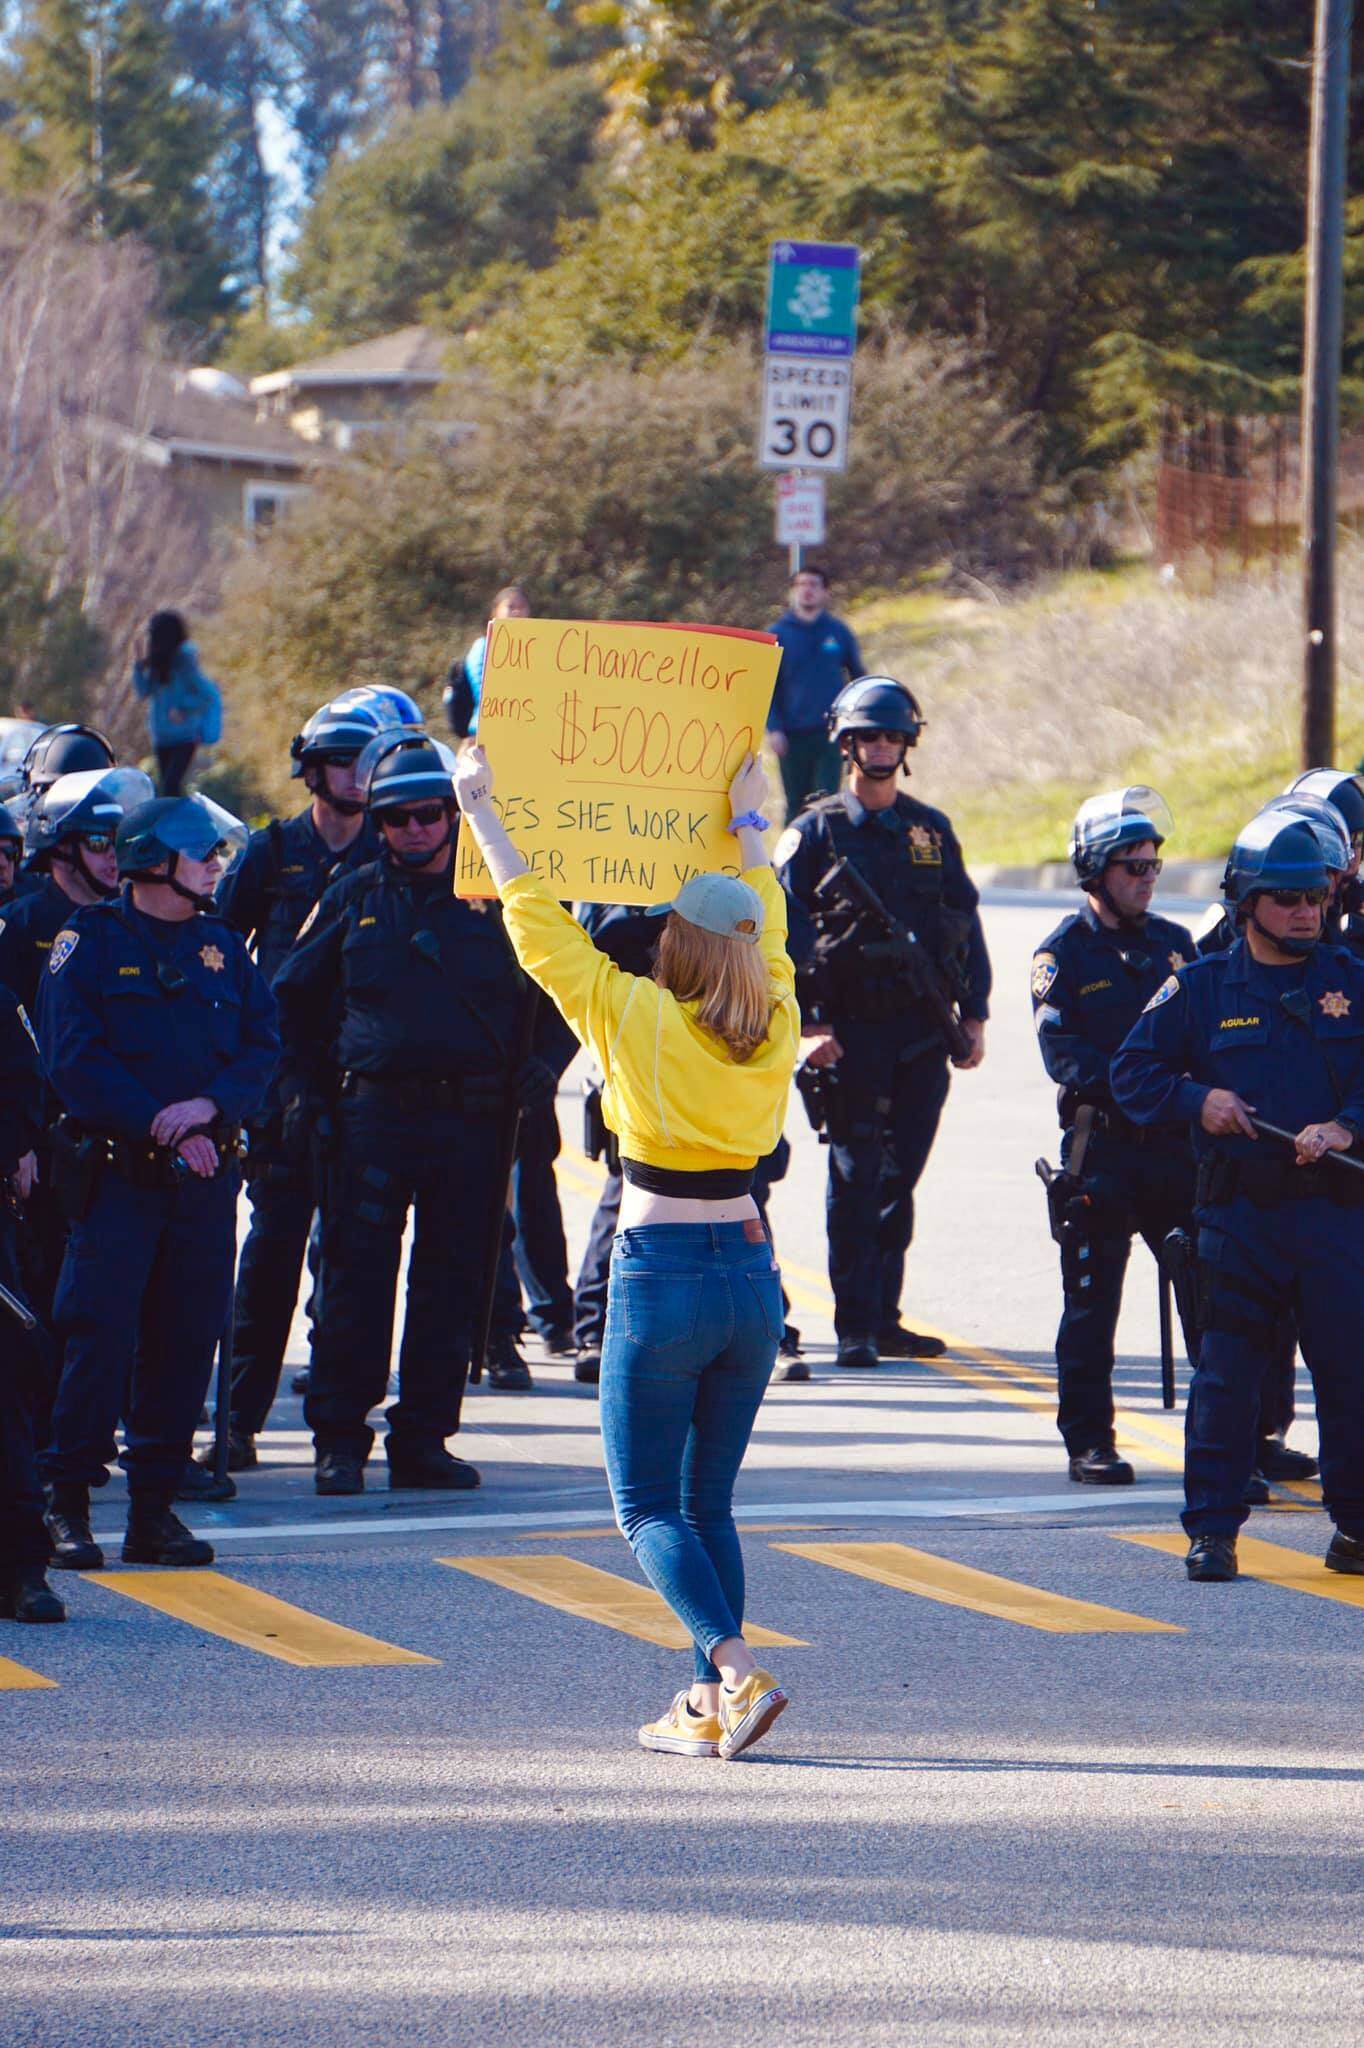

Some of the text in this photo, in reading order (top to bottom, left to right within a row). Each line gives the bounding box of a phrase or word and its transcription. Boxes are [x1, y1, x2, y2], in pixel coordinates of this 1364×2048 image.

[771, 366, 848, 386] SPEED
[773, 391, 836, 412] LIMIT
[771, 419, 836, 459] 30
[491, 624, 749, 691] Our Chancellor
[480, 695, 537, 722] earns
[556, 800, 615, 832] SHE
[627, 804, 710, 850] WORK
[583, 856, 657, 890] THAN
[1220, 1016, 1260, 1029] AGUILAR
